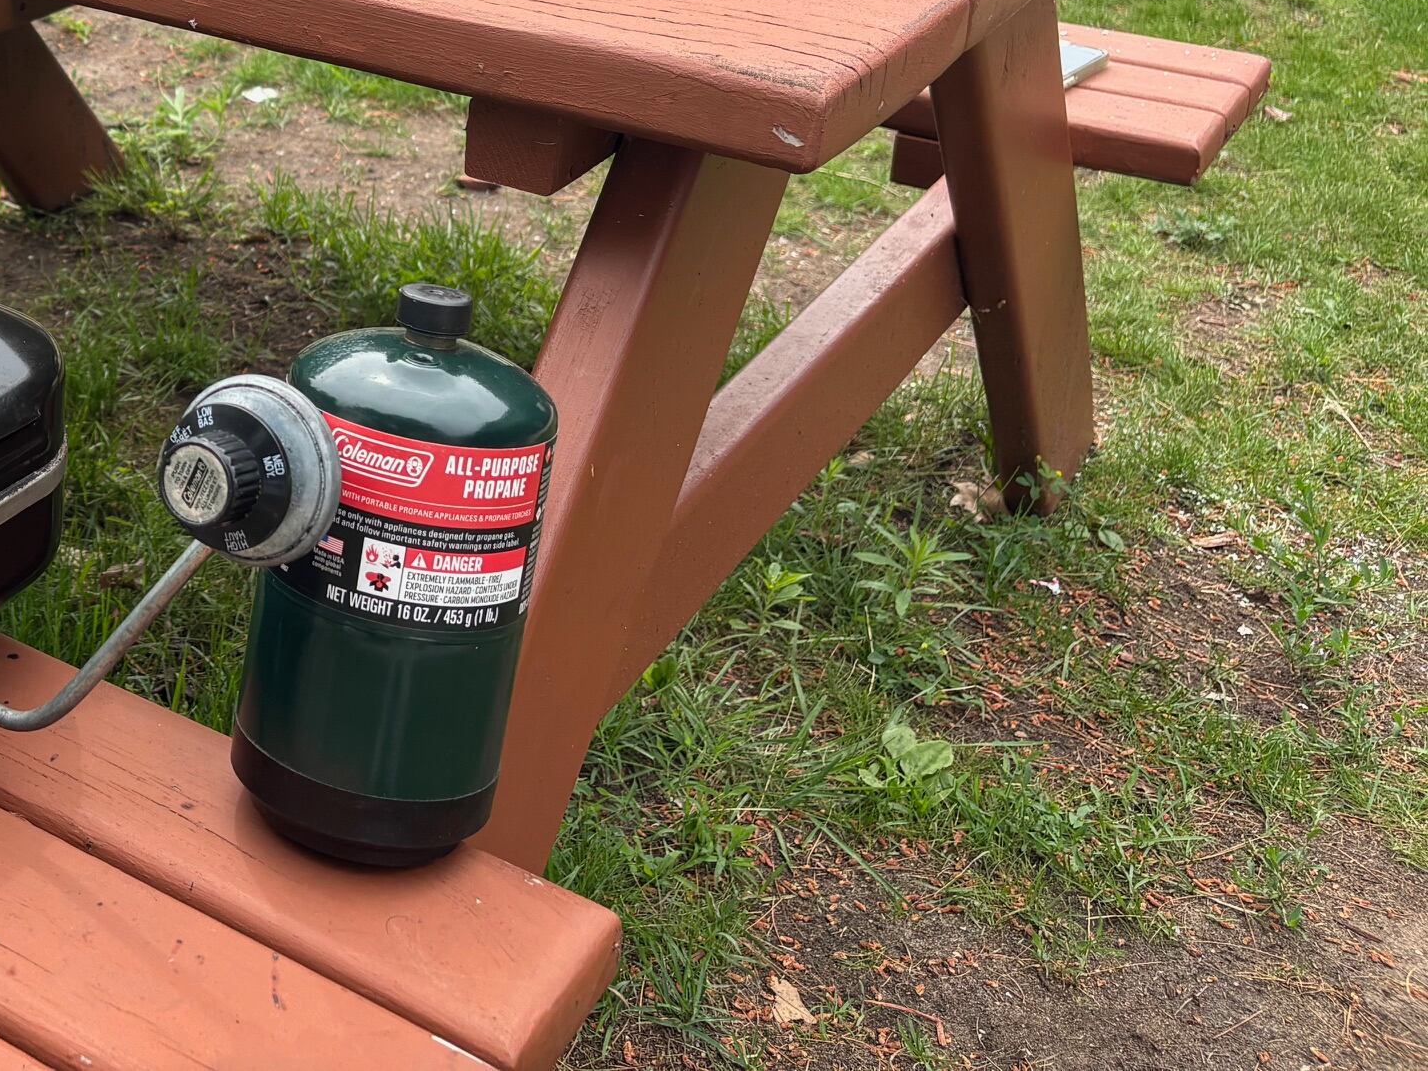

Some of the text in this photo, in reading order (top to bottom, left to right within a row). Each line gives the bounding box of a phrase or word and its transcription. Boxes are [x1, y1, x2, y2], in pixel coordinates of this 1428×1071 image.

[196, 406, 212, 419] LOW
[197, 416, 214, 429] BAS
[169, 425, 181, 443] OFF
[445, 453, 540, 477] ALL-PURPOSE
[182, 469, 203, 503] Coleman
[463, 477, 526, 499] PROPANE
[341, 489, 360, 502] WITH
[360, 496, 397, 512] PORTABLE
[398, 505, 434, 519] PROPANE
[434, 510, 478, 522] APPLIANCES
[484, 513, 511, 522] PROPANE
[511, 508, 532, 520] TORCHES
[341, 519, 355, 529] and
[356, 522, 380, 537] follow
[381, 530, 421, 547] important
[421, 537, 447, 550] safety
[448, 541, 482, 552] warnings
[492, 540, 506, 549] side
[347, 511, 364, 524] only
[364, 516, 382, 528] with
[383, 521, 427, 537] appliances
[428, 529, 464, 541] designed
[464, 532, 475, 541] for
[476, 533, 503, 542] propane
[503, 531, 515, 541] gas.
[313, 546, 327, 558] Made
[332, 555, 345, 565] USA
[325, 558, 342, 569] global
[433, 554, 483, 572] DANGER
[405, 579, 518, 595] EXPLOSION HAZARD CONTENTS UNDER
[406, 571, 503, 585] EXTREMELY FLAMMABLE FIRE/
[326, 584, 499, 628] NET WEIGHT 16 OZ. / 453 g (1 lb.)
[404, 589, 517, 605] PRESSURE CARBON MONOXIDE HAZARD
